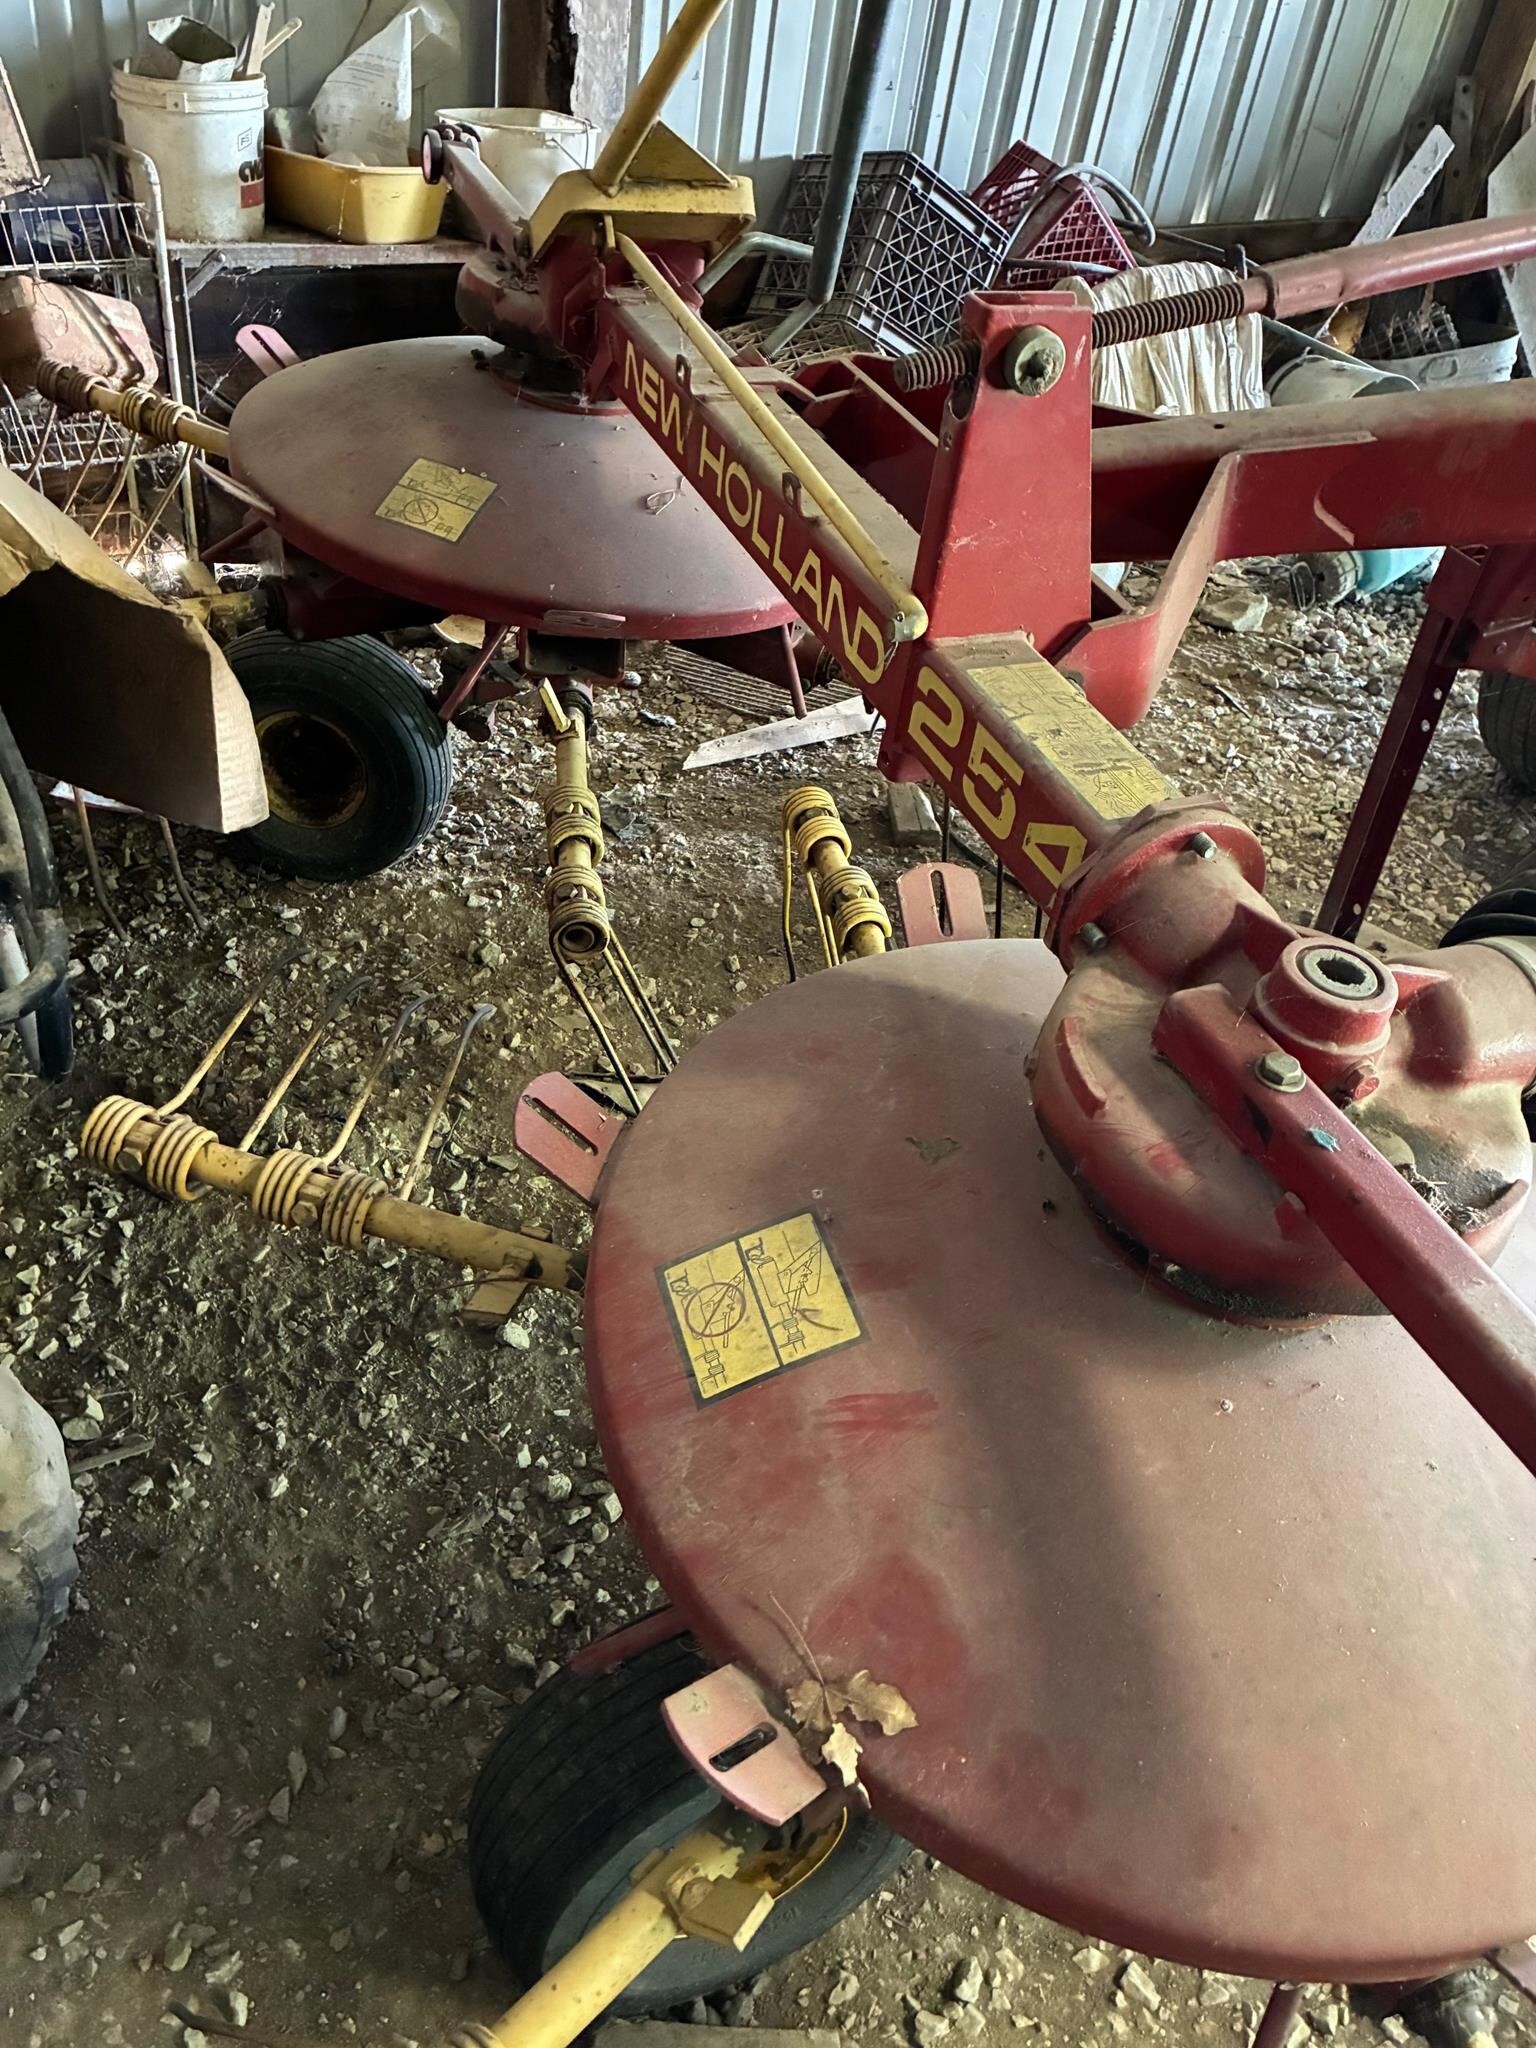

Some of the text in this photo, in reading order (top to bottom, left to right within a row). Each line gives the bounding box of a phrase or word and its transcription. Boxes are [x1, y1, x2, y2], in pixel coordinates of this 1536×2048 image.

[625, 341, 885, 685] NEW HOLLAND
[908, 666, 1088, 889] 254
